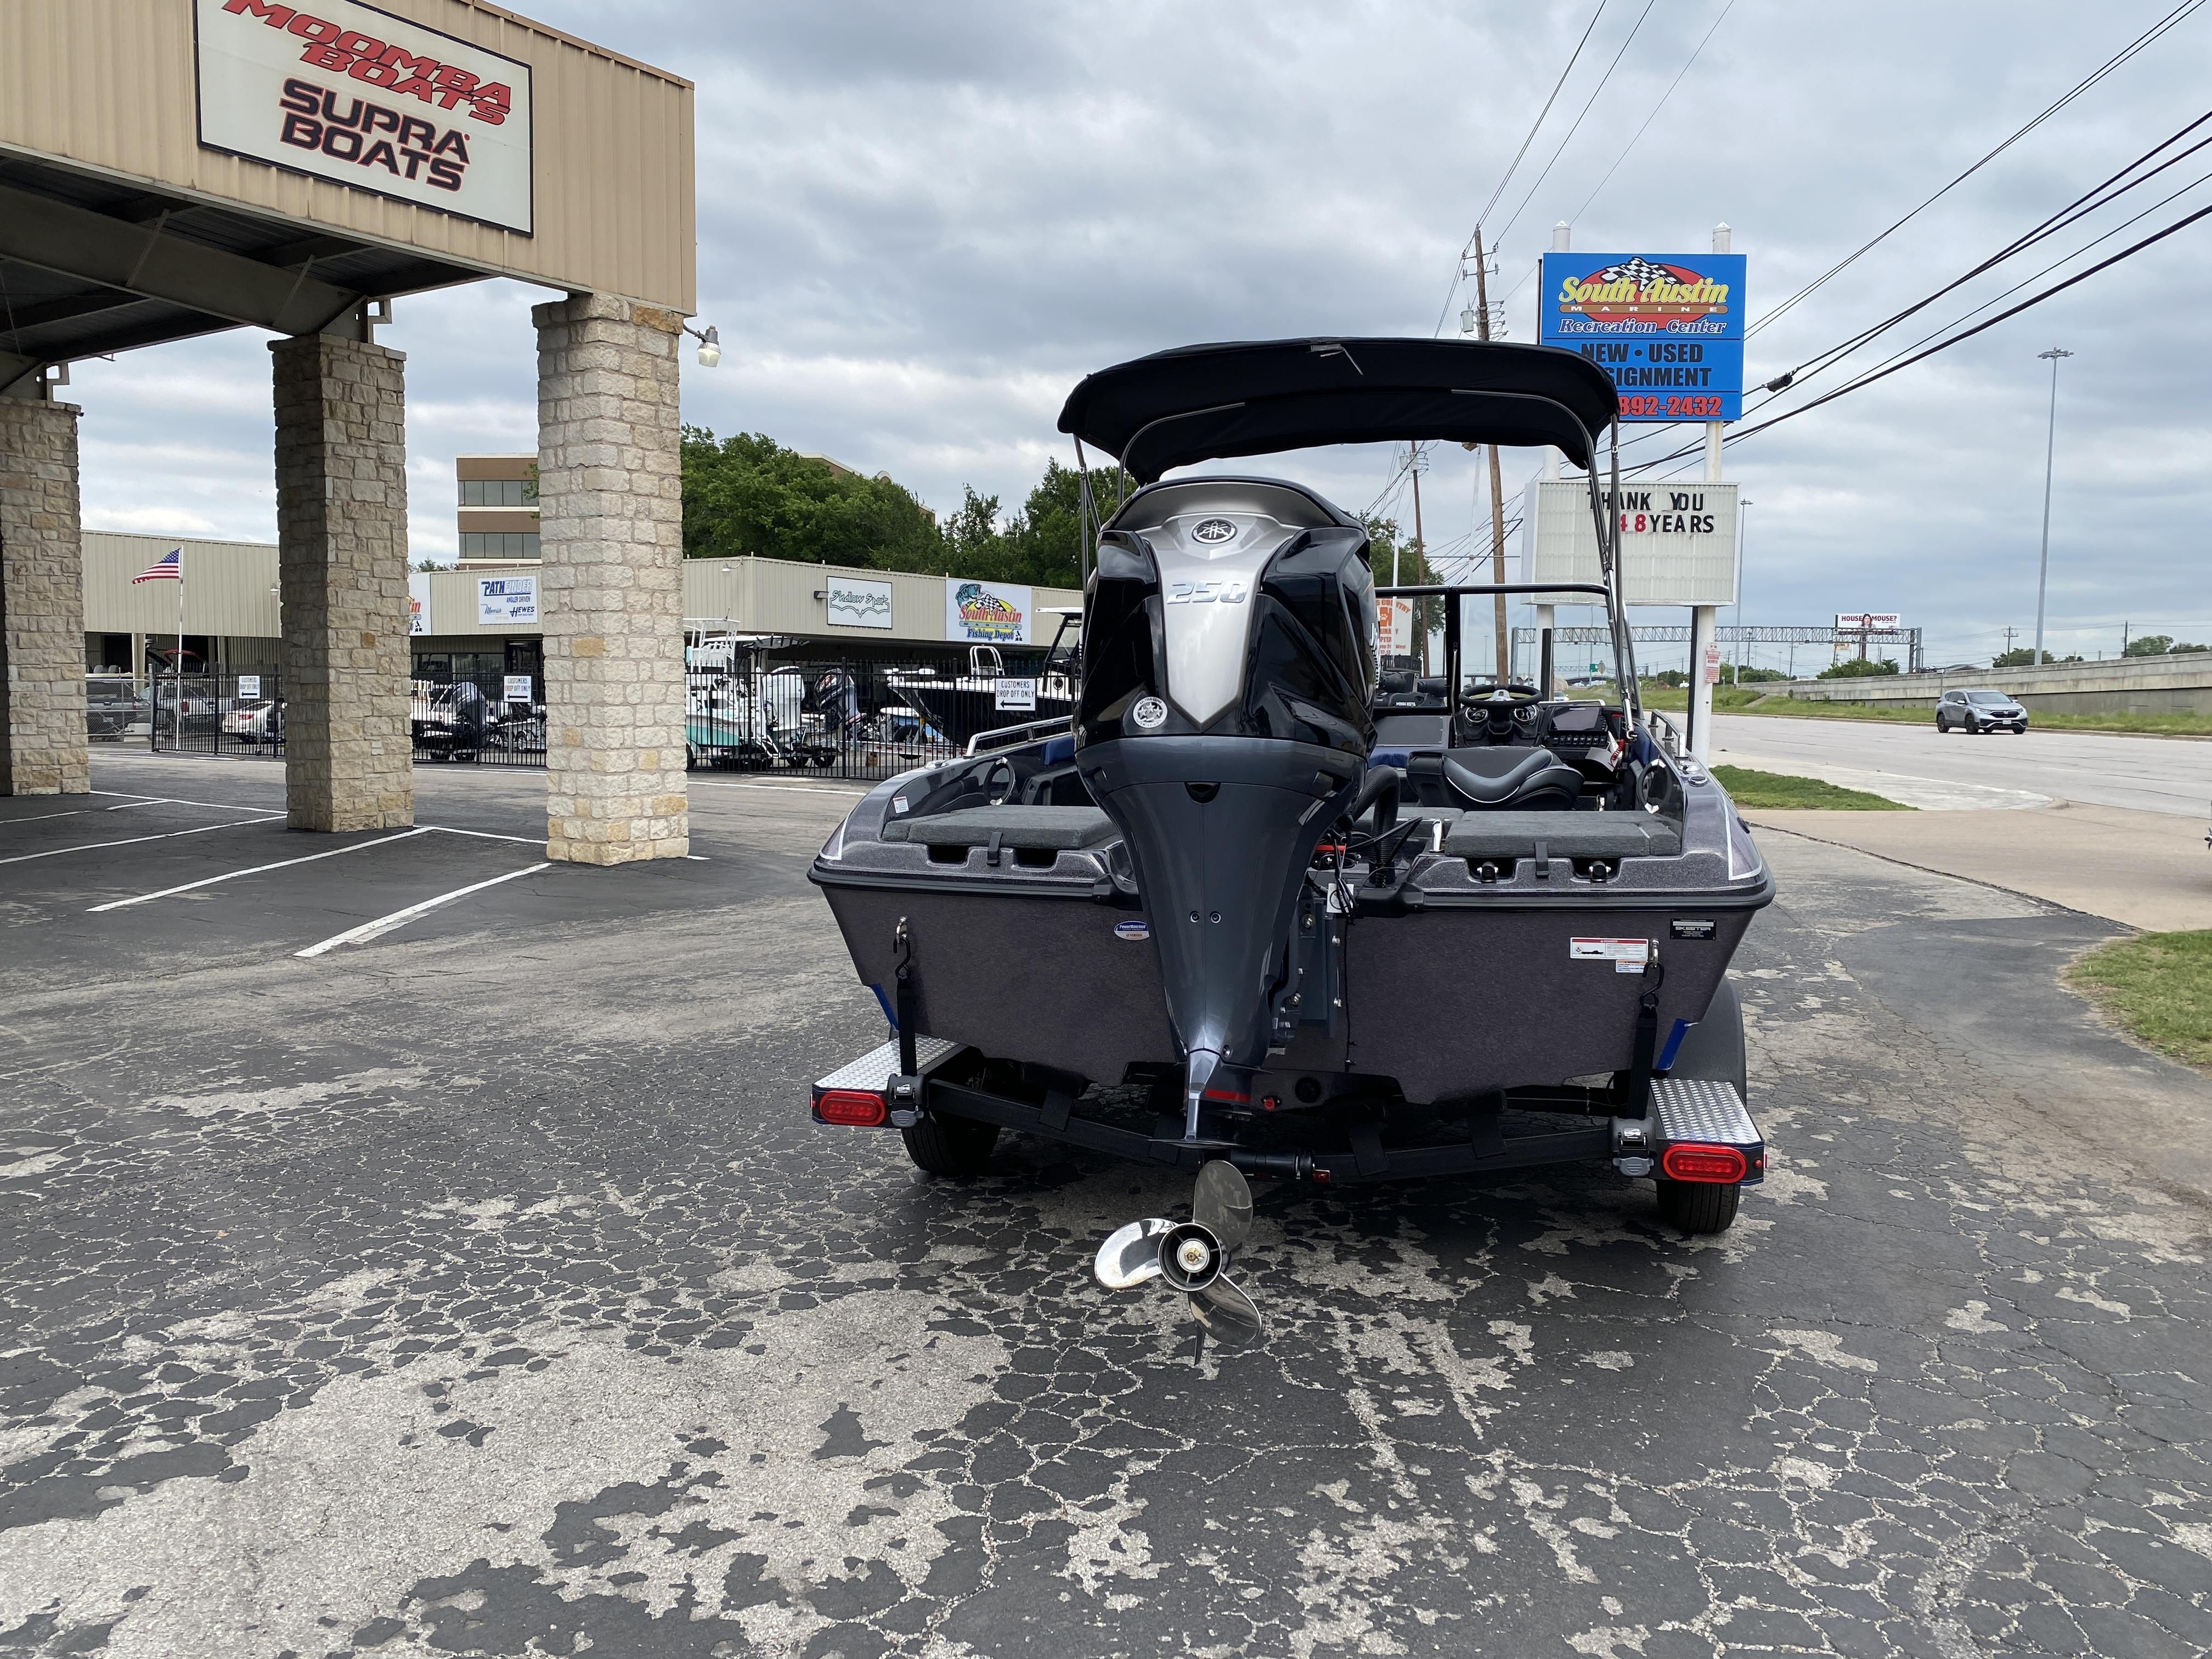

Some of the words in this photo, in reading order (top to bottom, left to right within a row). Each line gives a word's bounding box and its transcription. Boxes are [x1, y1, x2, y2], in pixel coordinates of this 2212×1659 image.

[221, 0, 511, 110] MOOMBA
[300, 42, 511, 125] BOATS
[280, 78, 470, 165] SUPRA
[280, 112, 466, 192] BOATS
[1559, 276, 1637, 303] South
[1640, 276, 1729, 303] Austin
[1558, 318, 1657, 334] Recreation
[1666, 319, 1728, 334] Center
[1581, 343, 1629, 362] NEW
[1649, 343, 1703, 363] USED
[1669, 492, 1703, 511] YOU
[1649, 515, 1714, 533] YEARS
[481, 579, 532, 596] PATHFINDER
[1166, 578, 1249, 604] 250
[833, 590, 865, 603] Shallow
[865, 593, 889, 607] Sport
[509, 606, 535, 617] HEWES
[959, 605, 988, 620] South
[990, 606, 1022, 623] Austin
[967, 628, 993, 641] Fishing
[995, 630, 1014, 642] Depot
